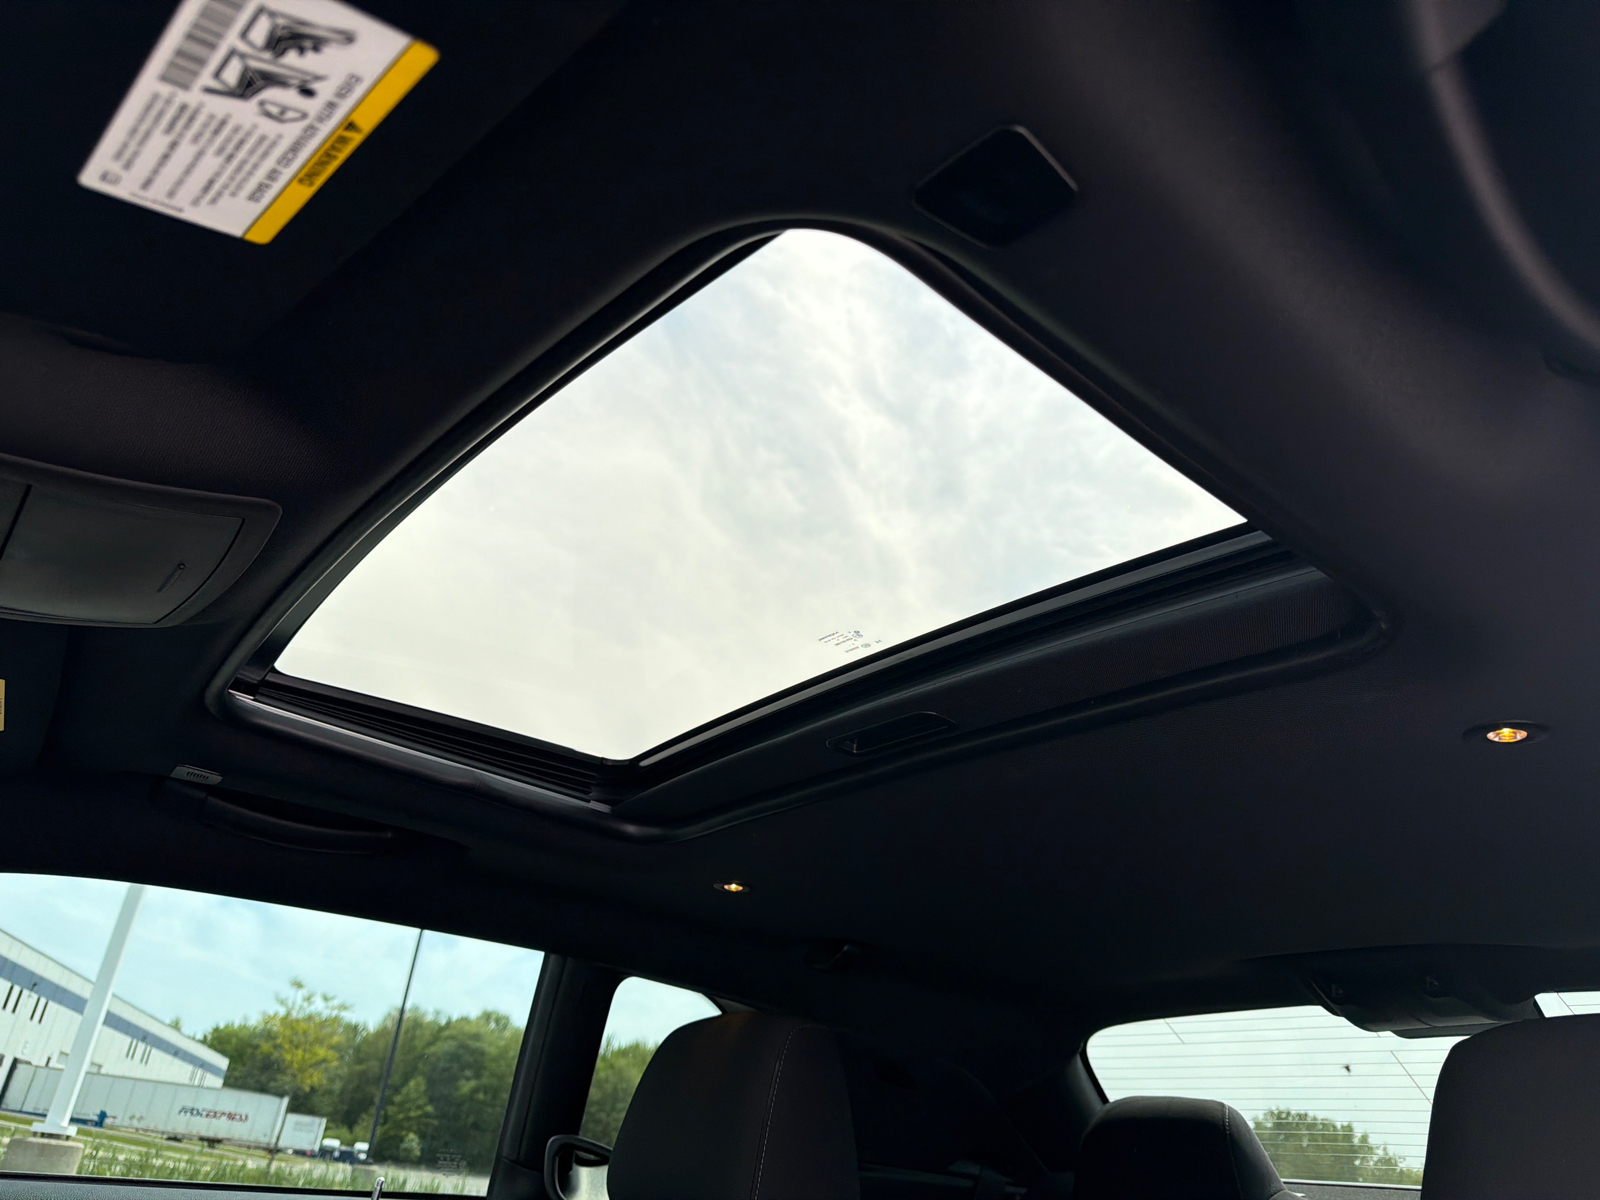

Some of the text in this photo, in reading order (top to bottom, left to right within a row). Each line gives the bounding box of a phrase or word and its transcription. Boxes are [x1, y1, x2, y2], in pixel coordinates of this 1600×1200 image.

[333, 72, 363, 99] EVEN
[314, 99, 339, 124] WITH
[276, 123, 321, 168] ADVANCED
[296, 133, 353, 188] WARNING
[265, 167, 283, 184] AIR
[246, 180, 272, 204] BAGS
